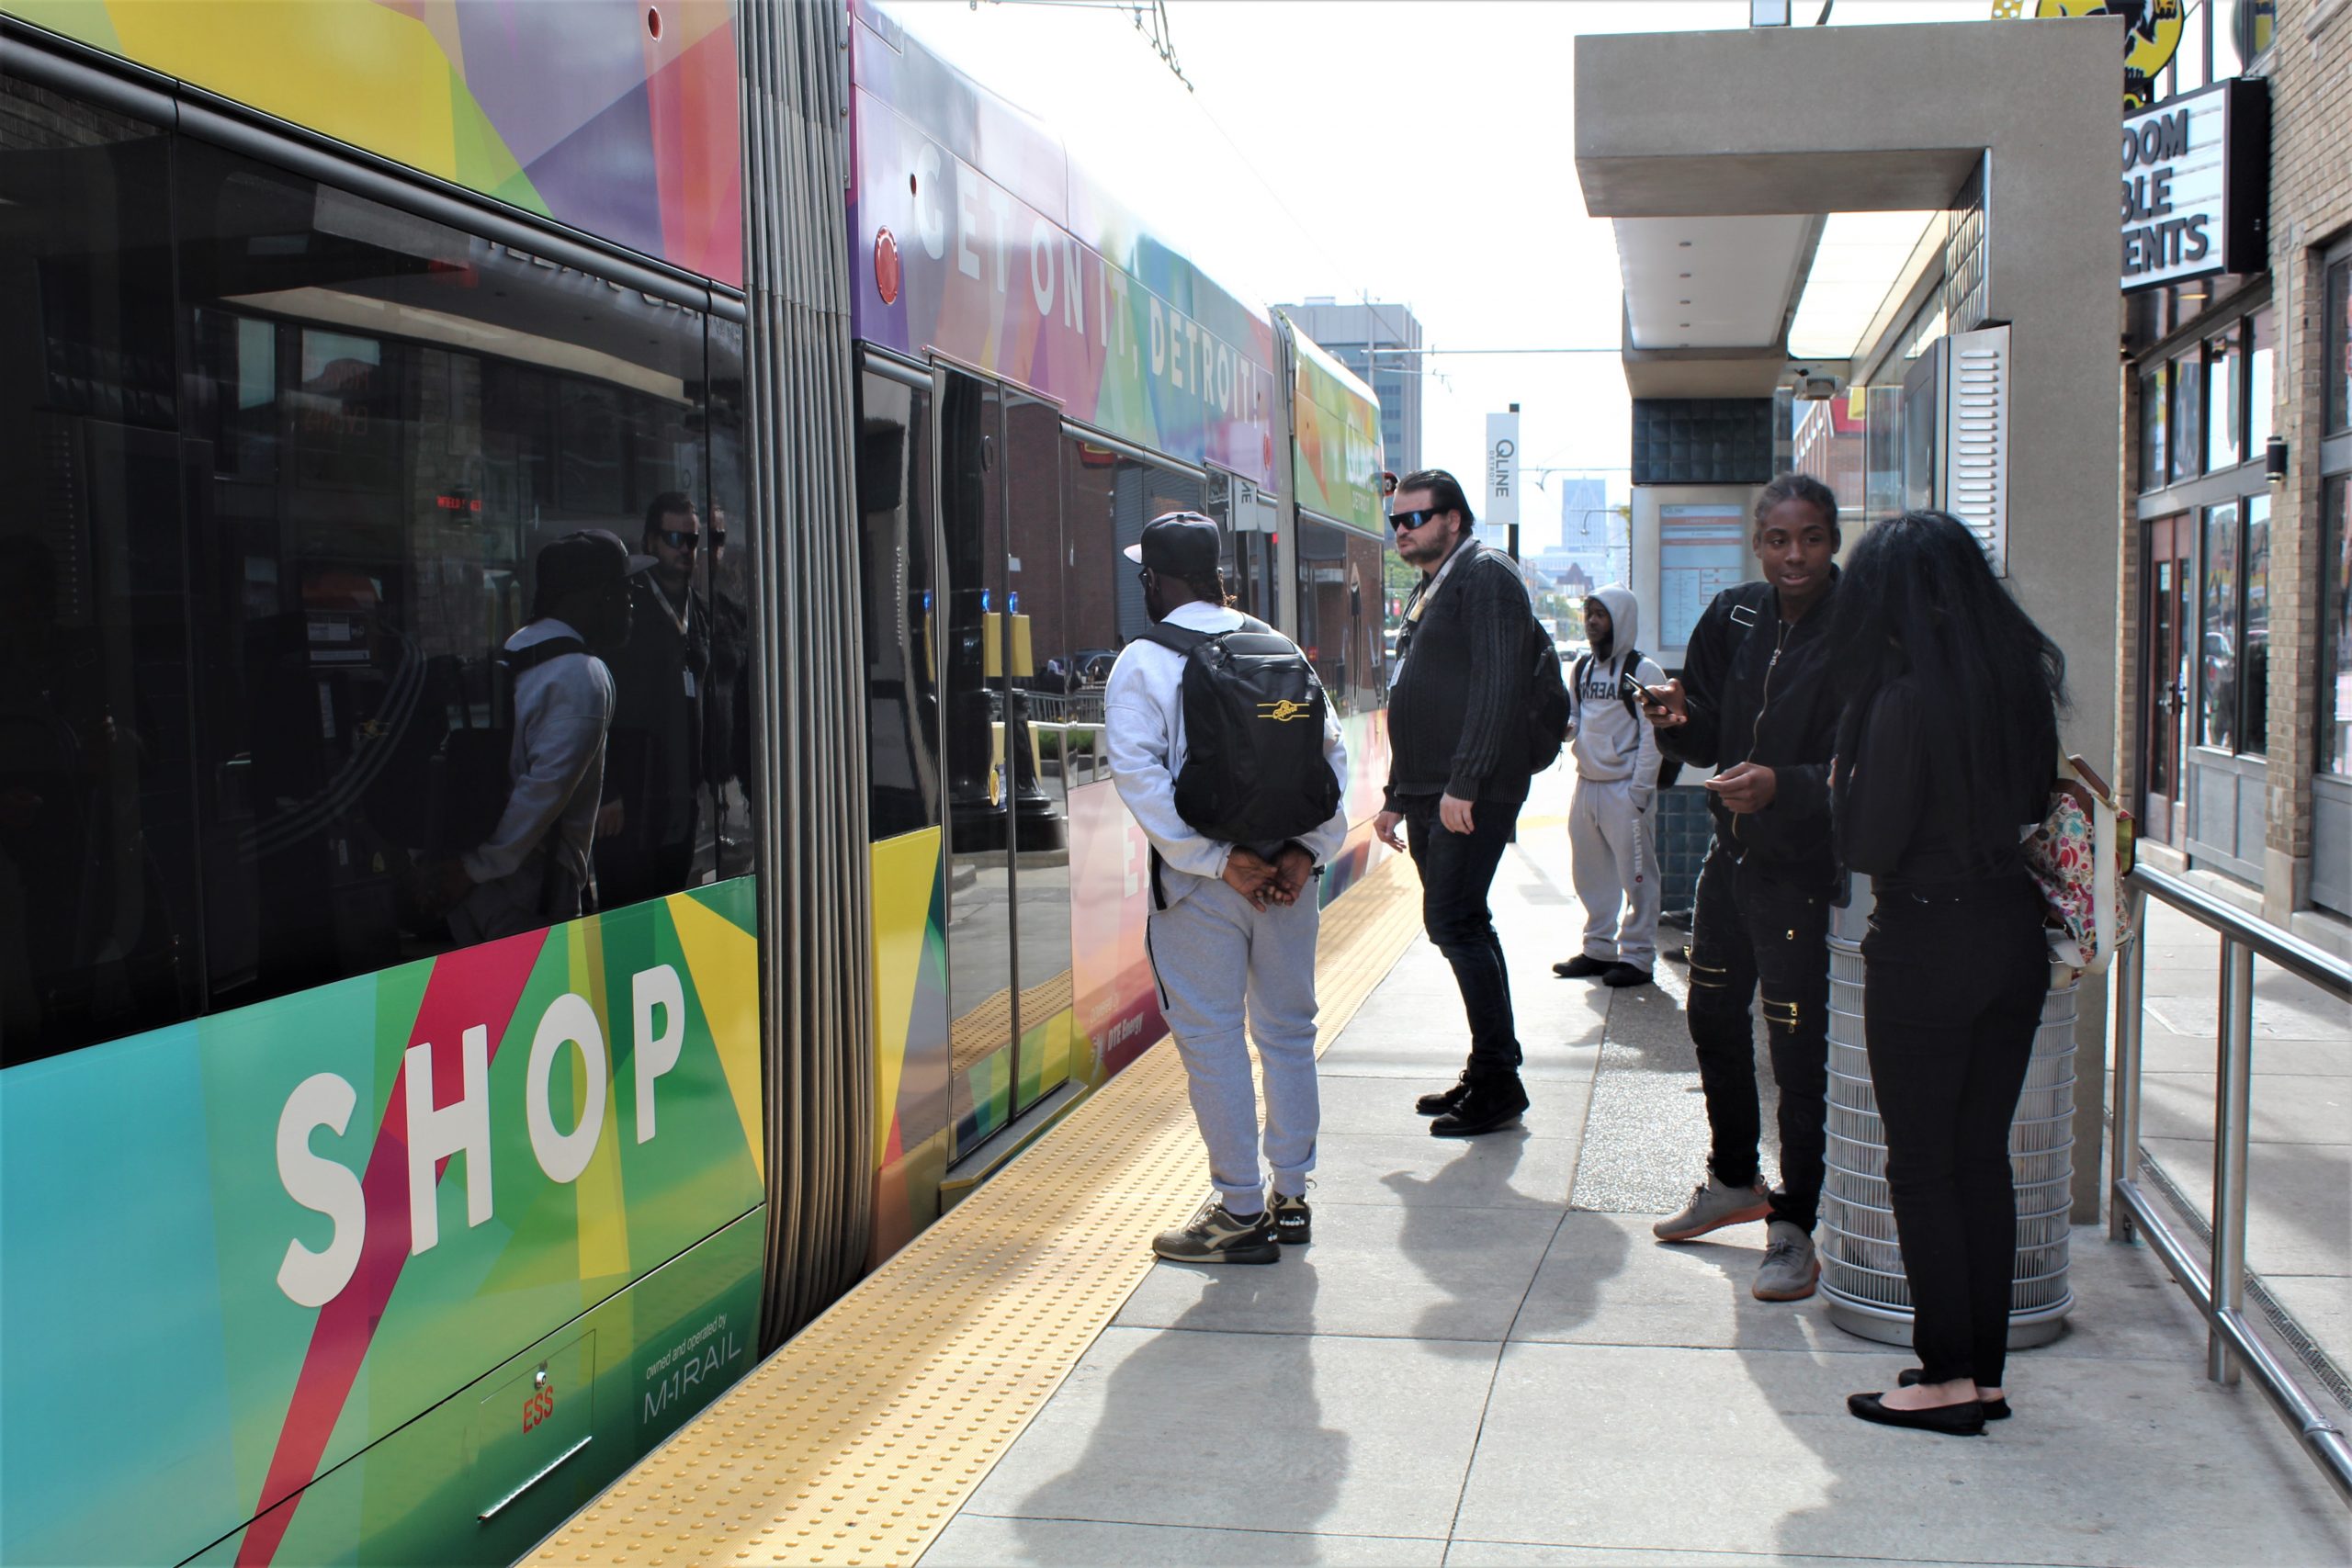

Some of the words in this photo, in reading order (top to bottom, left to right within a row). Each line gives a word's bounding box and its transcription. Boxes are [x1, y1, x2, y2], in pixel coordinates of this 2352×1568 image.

[914, 142, 1010, 294] GET
[1031, 217, 1084, 335] ON
[1099, 259, 1139, 381] IT,
[1150, 296, 1258, 429] DETROIT!
[1496, 439, 1514, 497] QLINE
[276, 964, 685, 1308] SHOP
[646, 1348, 671, 1380] owned
[673, 1337, 685, 1361] and
[686, 1316, 718, 1351] operated
[718, 1313, 727, 1330] by
[523, 1385, 553, 1434] ESS
